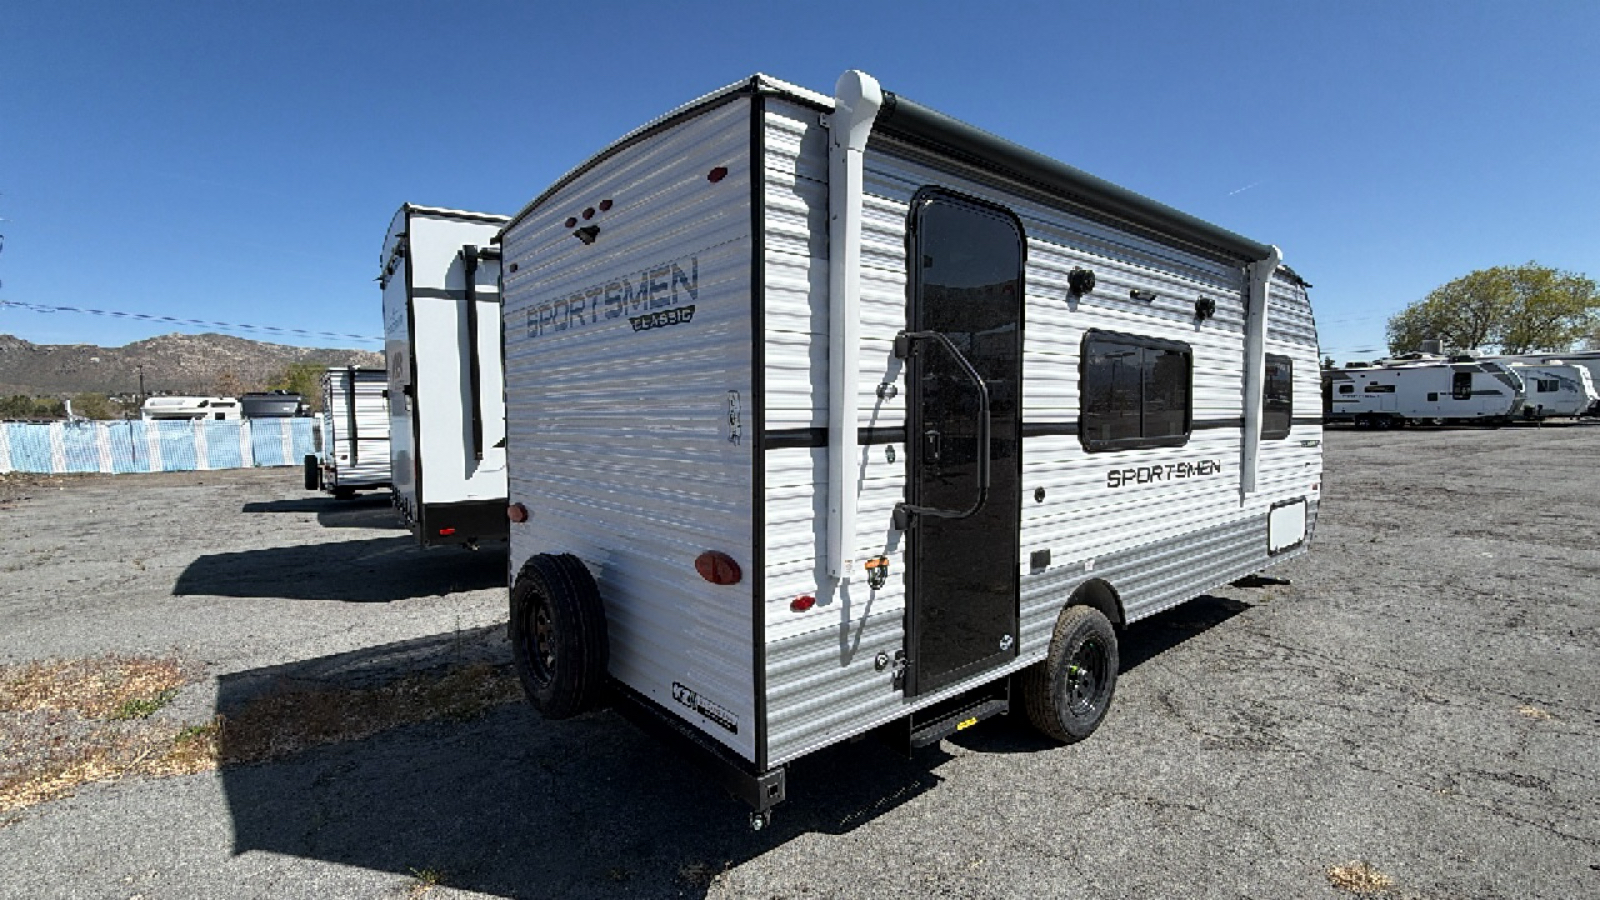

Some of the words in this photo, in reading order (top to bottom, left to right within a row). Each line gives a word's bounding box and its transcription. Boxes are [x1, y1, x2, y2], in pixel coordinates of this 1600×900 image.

[527, 257, 698, 337] SPORTSMEN
[634, 308, 692, 330] CLASSIC
[1107, 459, 1220, 488] SPORTSMEN
